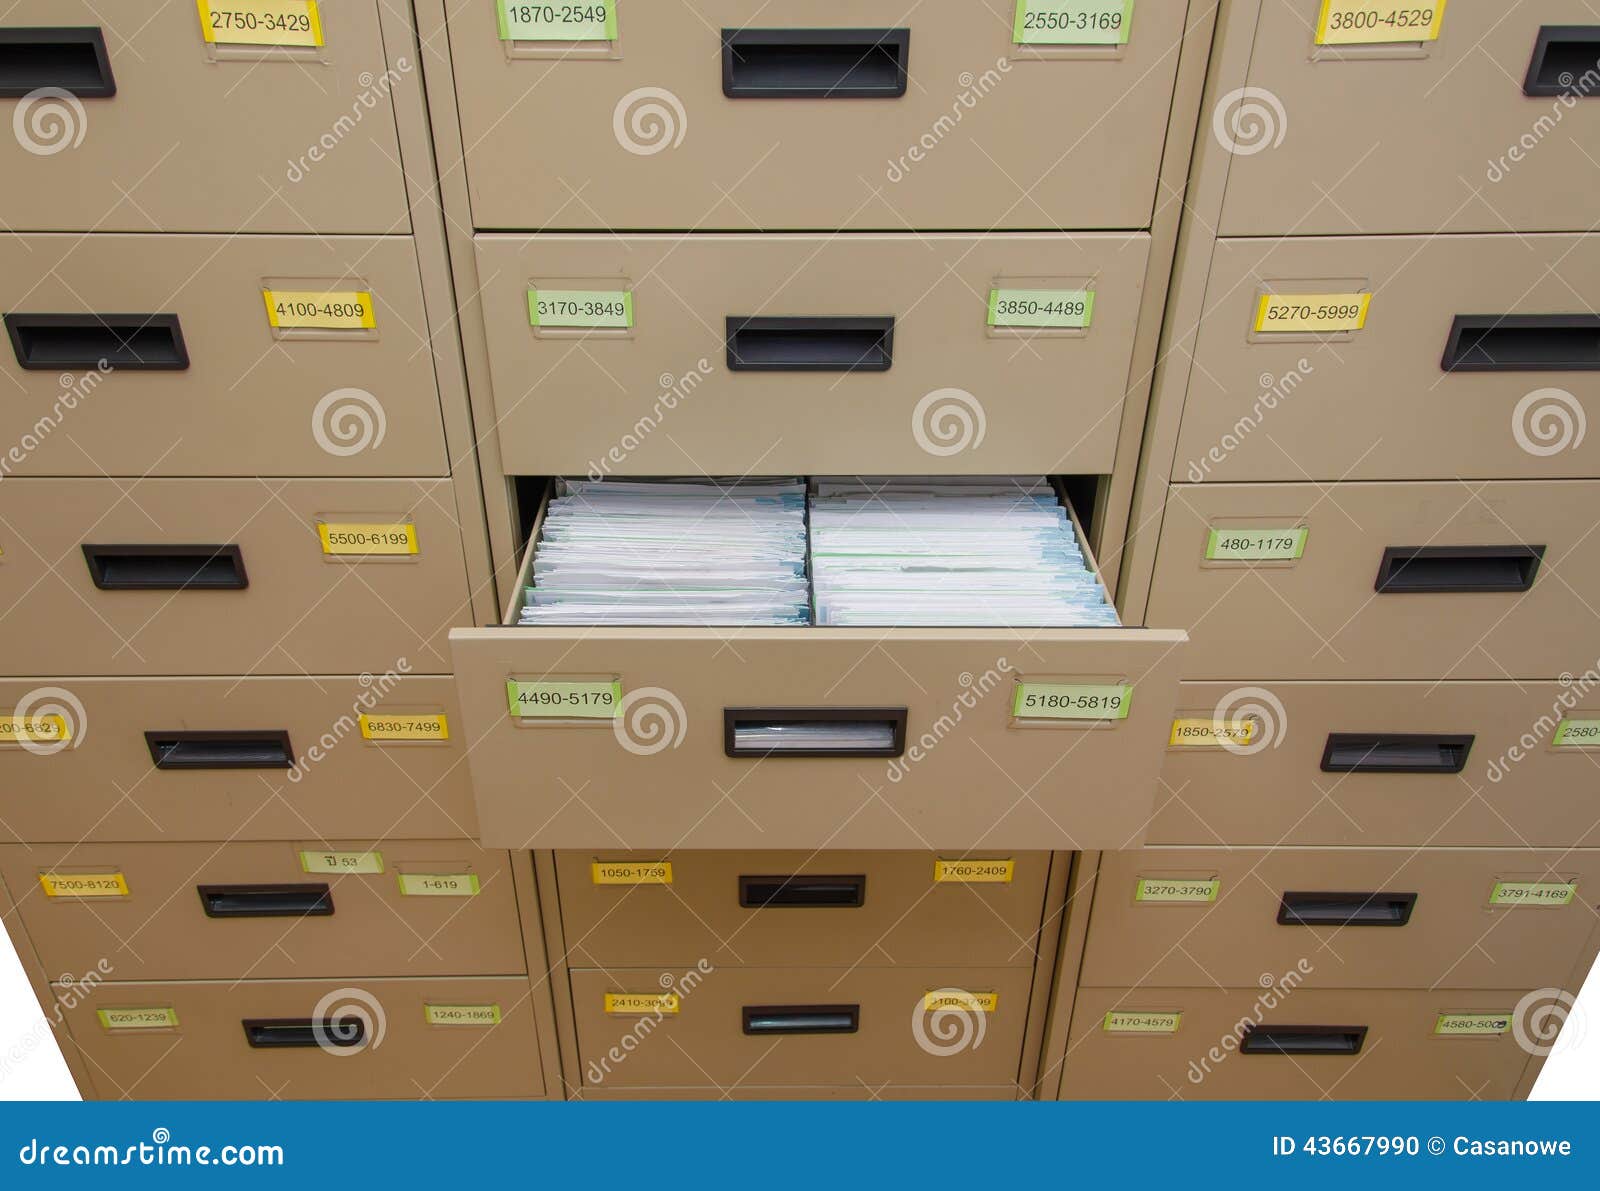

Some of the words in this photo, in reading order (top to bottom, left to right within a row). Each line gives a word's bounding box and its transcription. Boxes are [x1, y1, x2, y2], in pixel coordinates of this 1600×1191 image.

[210, 11, 310, 31] 2750-3429
[509, 5, 606, 23] 1870-2549
[1023, 11, 1123, 30] 2550-3169
[1330, 8, 1432, 30] 3800-4529
[276, 302, 365, 318] 4100-4809
[537, 301, 625, 317] 3170-3849
[997, 300, 1085, 316] 3850-4489
[1267, 305, 1359, 321] 5270-5999
[328, 532, 409, 546] 5500-6199
[1220, 537, 1293, 551] 480-1179
[517, 692, 613, 706] 4490-5179
[1025, 694, 1121, 709] 5180-5819
[368, 721, 441, 733] 6830-7499
[342, 858, 358, 866] 53
[601, 868, 665, 878] 1050-1759
[942, 866, 1006, 876] 1760-2409
[50, 880, 120, 891] 7500-8120
[423, 881, 457, 890] 1-619
[1143, 885, 1212, 897] 3270-3790
[1498, 888, 1569, 899] 3791-4169
[433, 1011, 495, 1019] 1240-1869
[1111, 1017, 1174, 1027] 4170-4579
